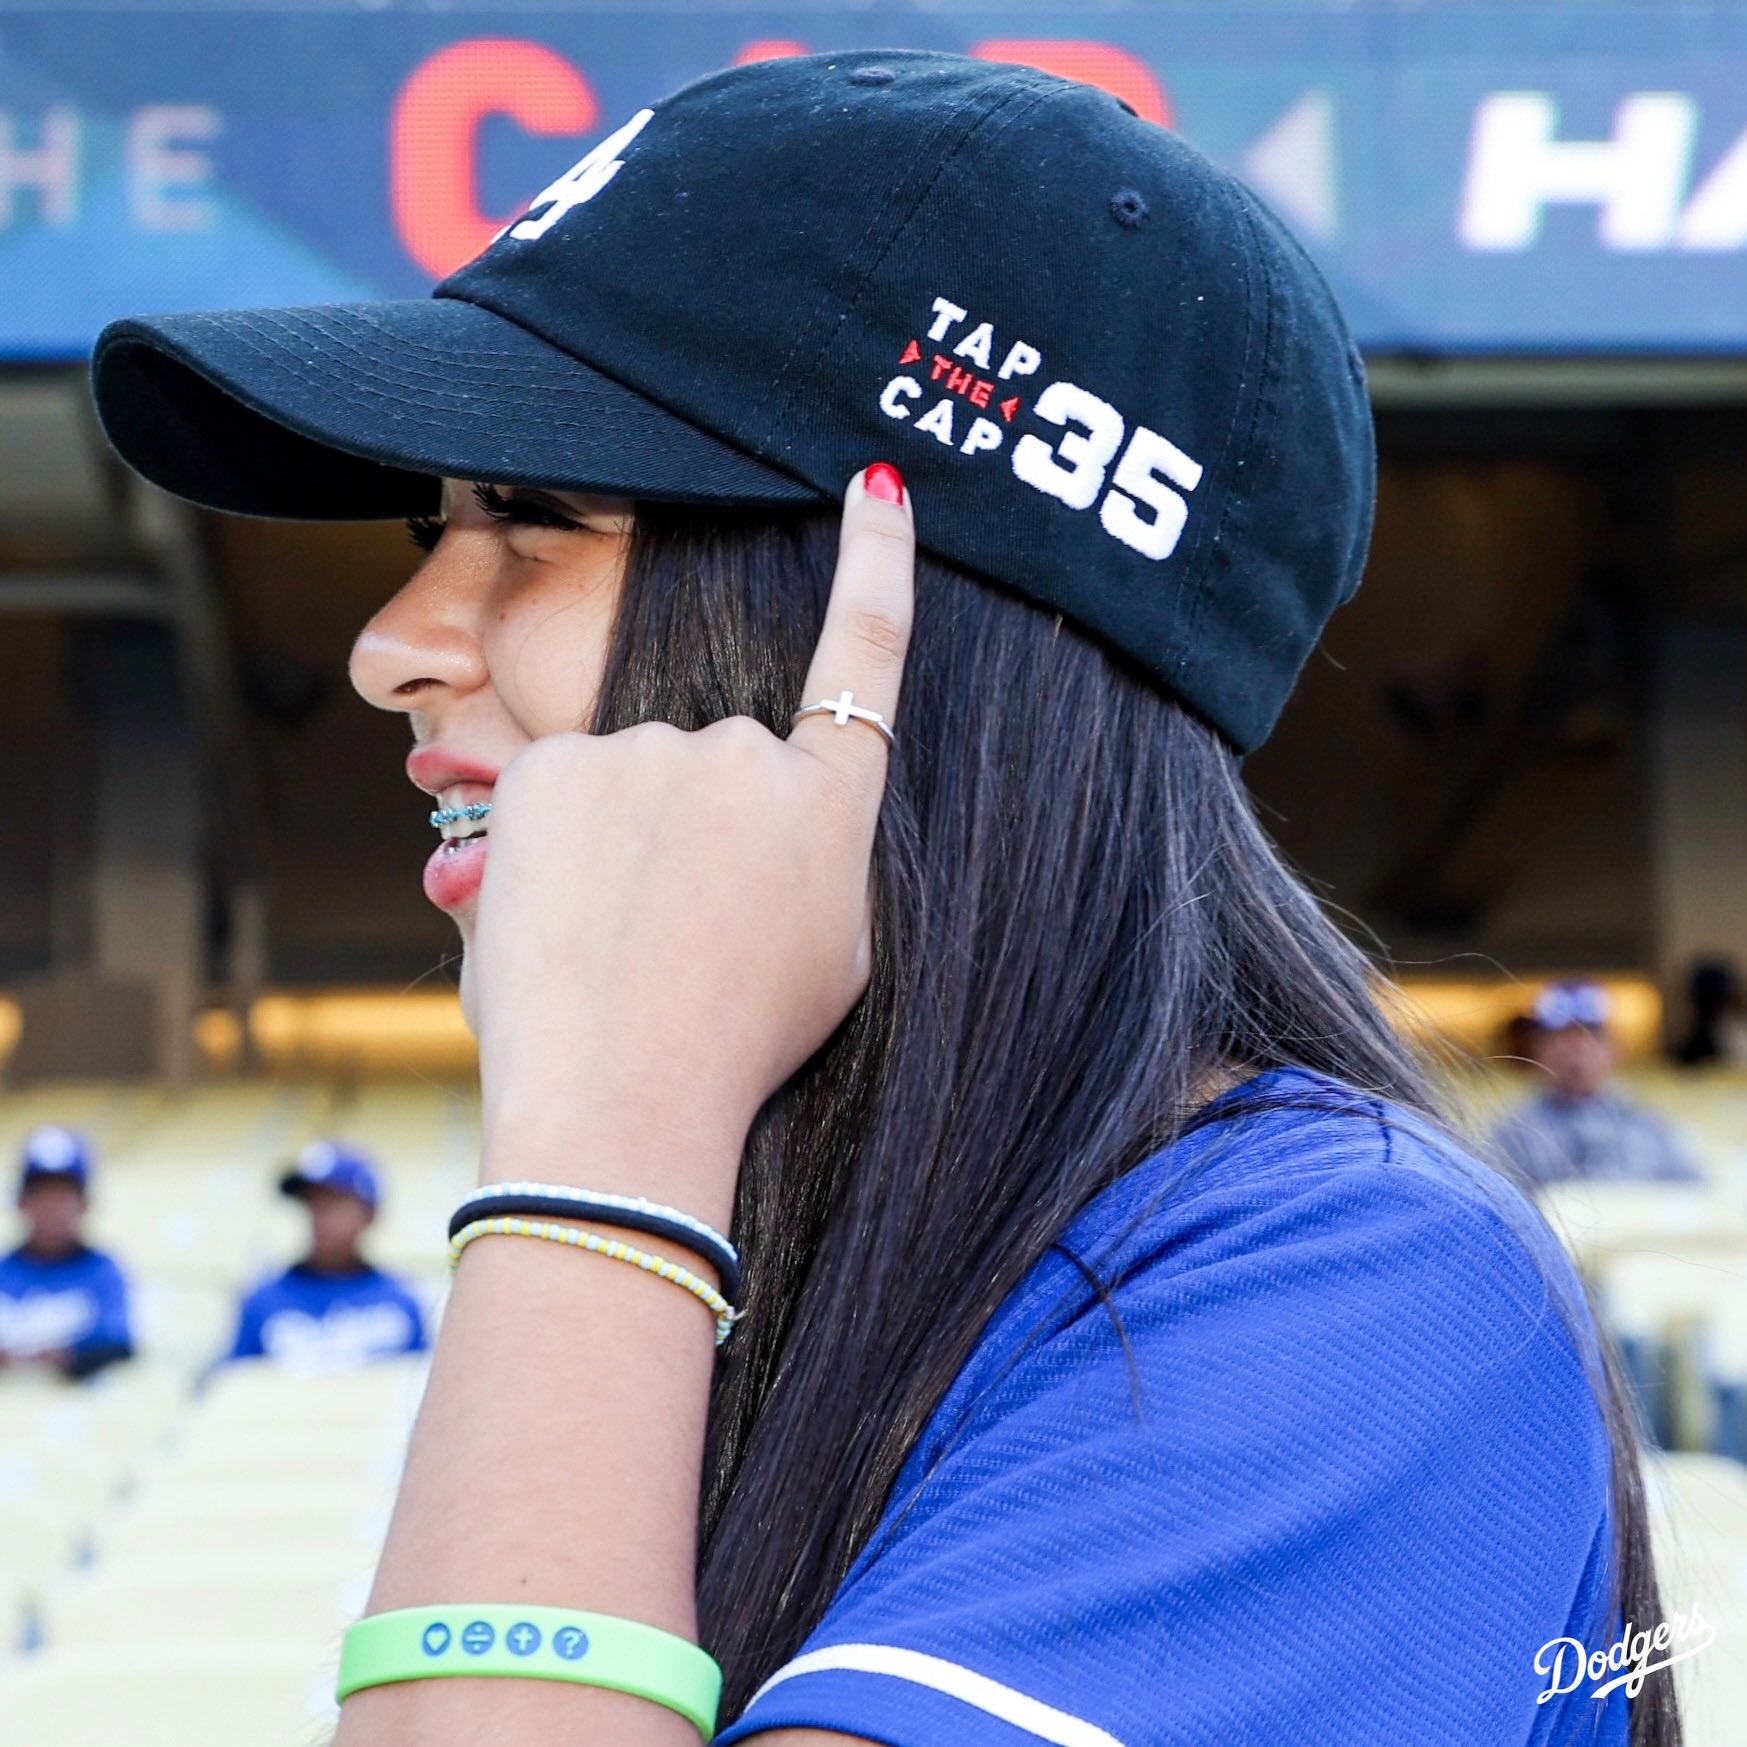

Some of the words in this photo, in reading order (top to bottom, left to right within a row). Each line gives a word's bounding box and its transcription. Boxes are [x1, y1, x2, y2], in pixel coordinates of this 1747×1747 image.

[927, 296, 1042, 380] TAP
[879, 375, 1004, 456] CAP
[929, 355, 995, 409] THE
[1011, 381, 1204, 561] 35
